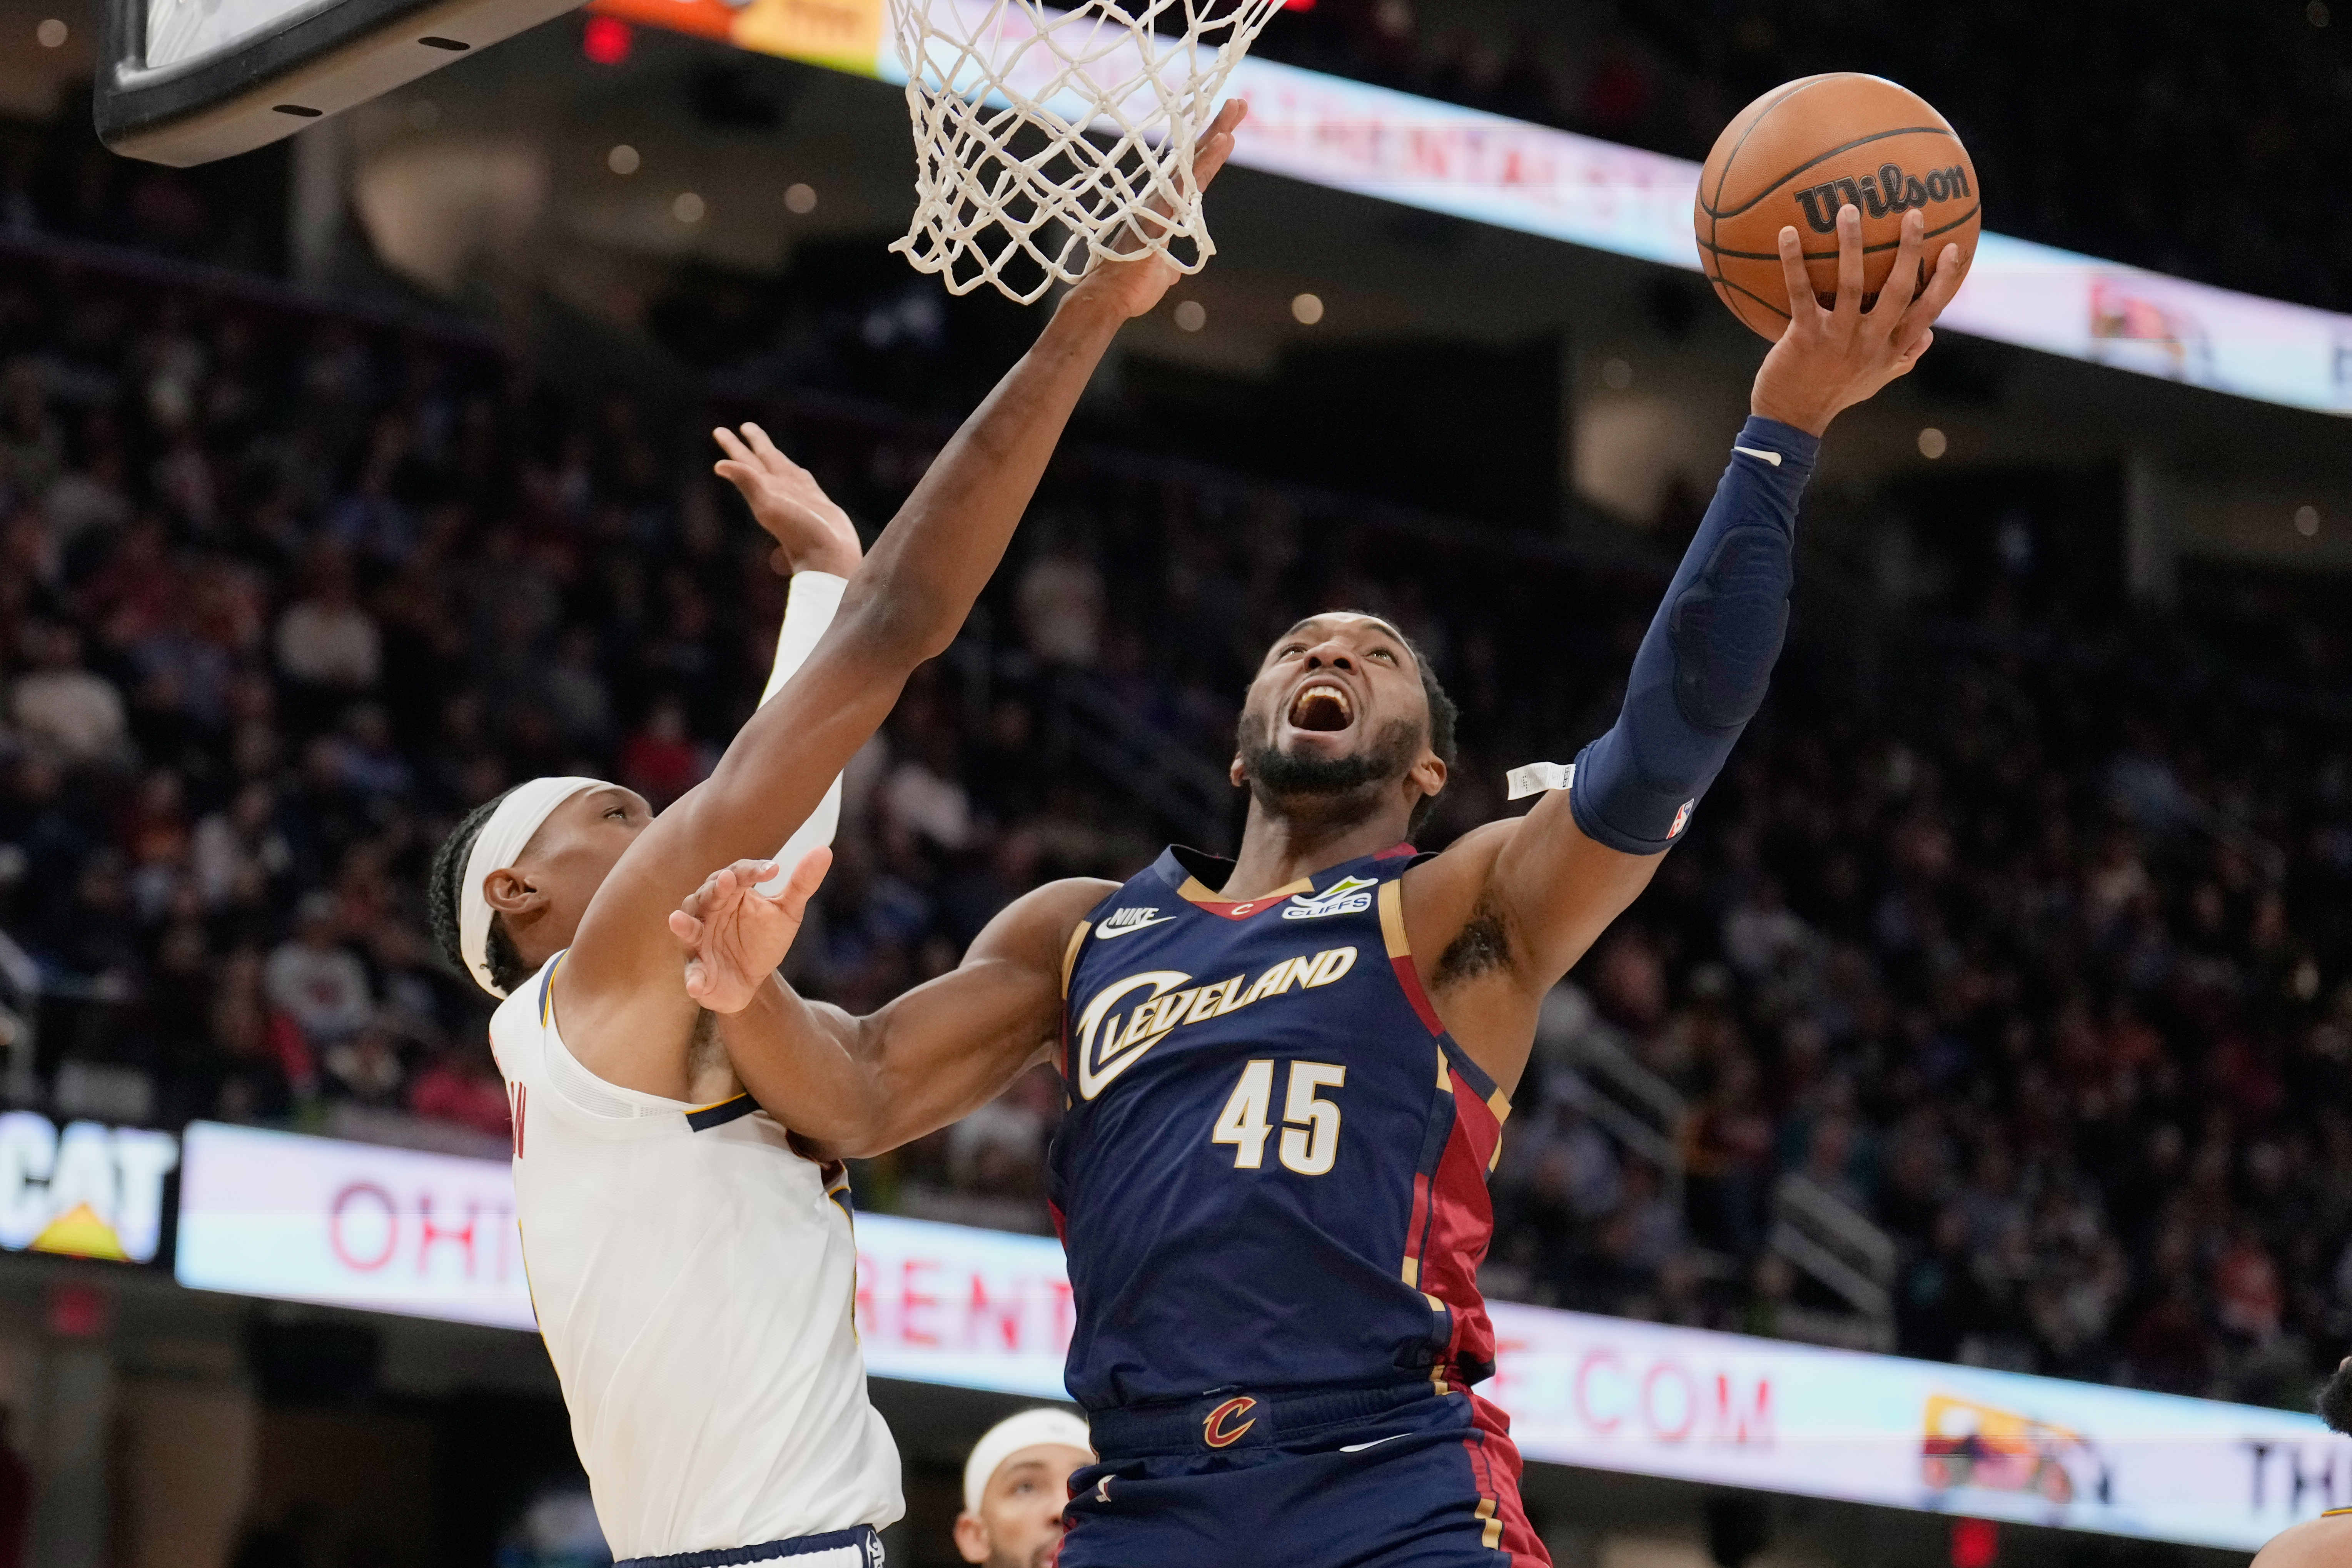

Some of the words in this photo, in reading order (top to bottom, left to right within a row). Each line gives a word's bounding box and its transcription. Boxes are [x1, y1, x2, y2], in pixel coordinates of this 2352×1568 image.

[1794, 163, 1971, 235] Wilson
[1108, 907, 1160, 926] NIKE
[1288, 897, 1368, 917] CLIFFS
[1076, 946, 1357, 1100] CLEVELAND
[1212, 1059, 1346, 1176] 45
[0, 1110, 179, 1264] CAT
[1202, 1396, 1257, 1448] C
